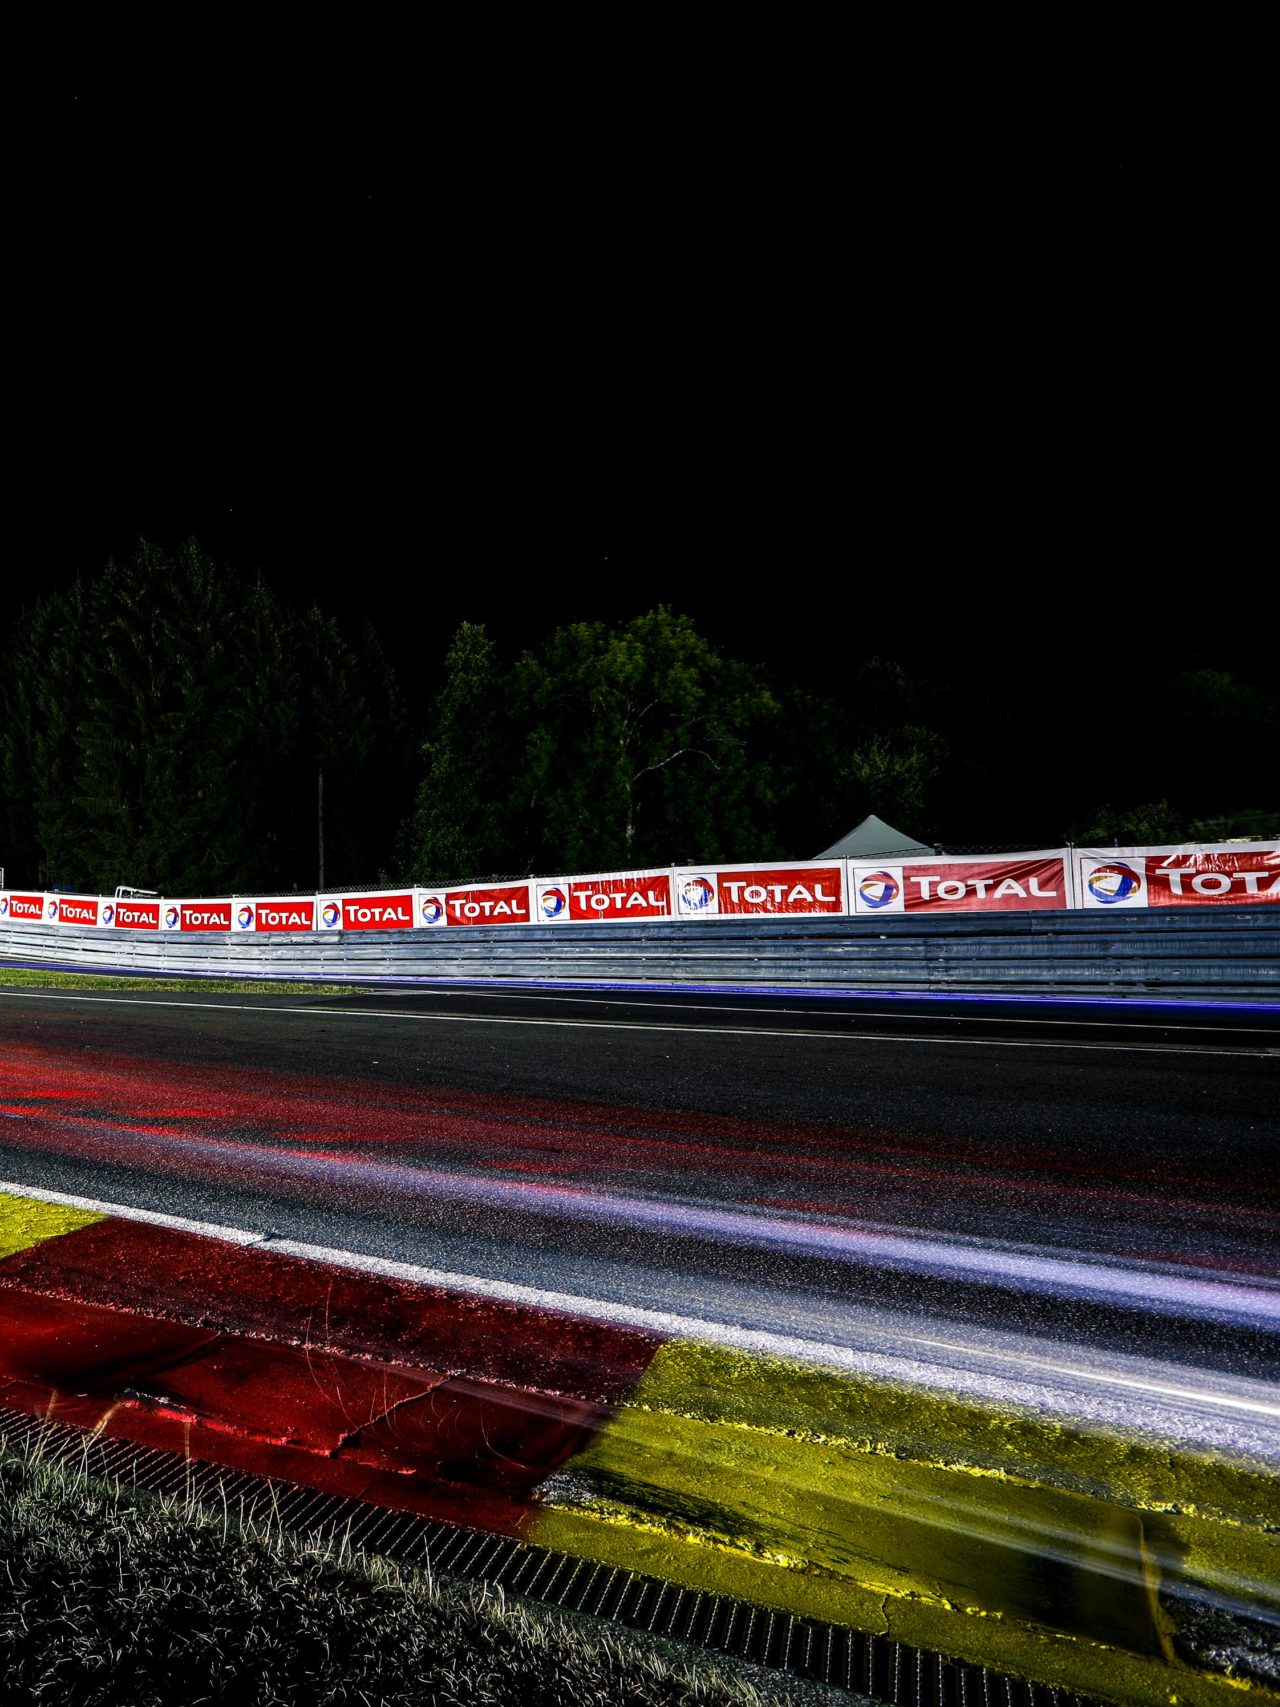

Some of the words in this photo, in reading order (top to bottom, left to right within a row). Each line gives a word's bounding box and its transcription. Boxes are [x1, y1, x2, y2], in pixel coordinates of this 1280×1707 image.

[723, 881, 836, 903] TOTAL
[910, 876, 1057, 900] TOTAL
[11, 900, 42, 914] TOTAL
[449, 899, 526, 917] TOTAL
[573, 890, 666, 911] TOTAL
[60, 904, 96, 920] TOTAL
[117, 909, 158, 924] TOTAL
[182, 910, 229, 925] TOTAL
[258, 909, 311, 926] TOTAL
[344, 906, 410, 922] TOTAL
